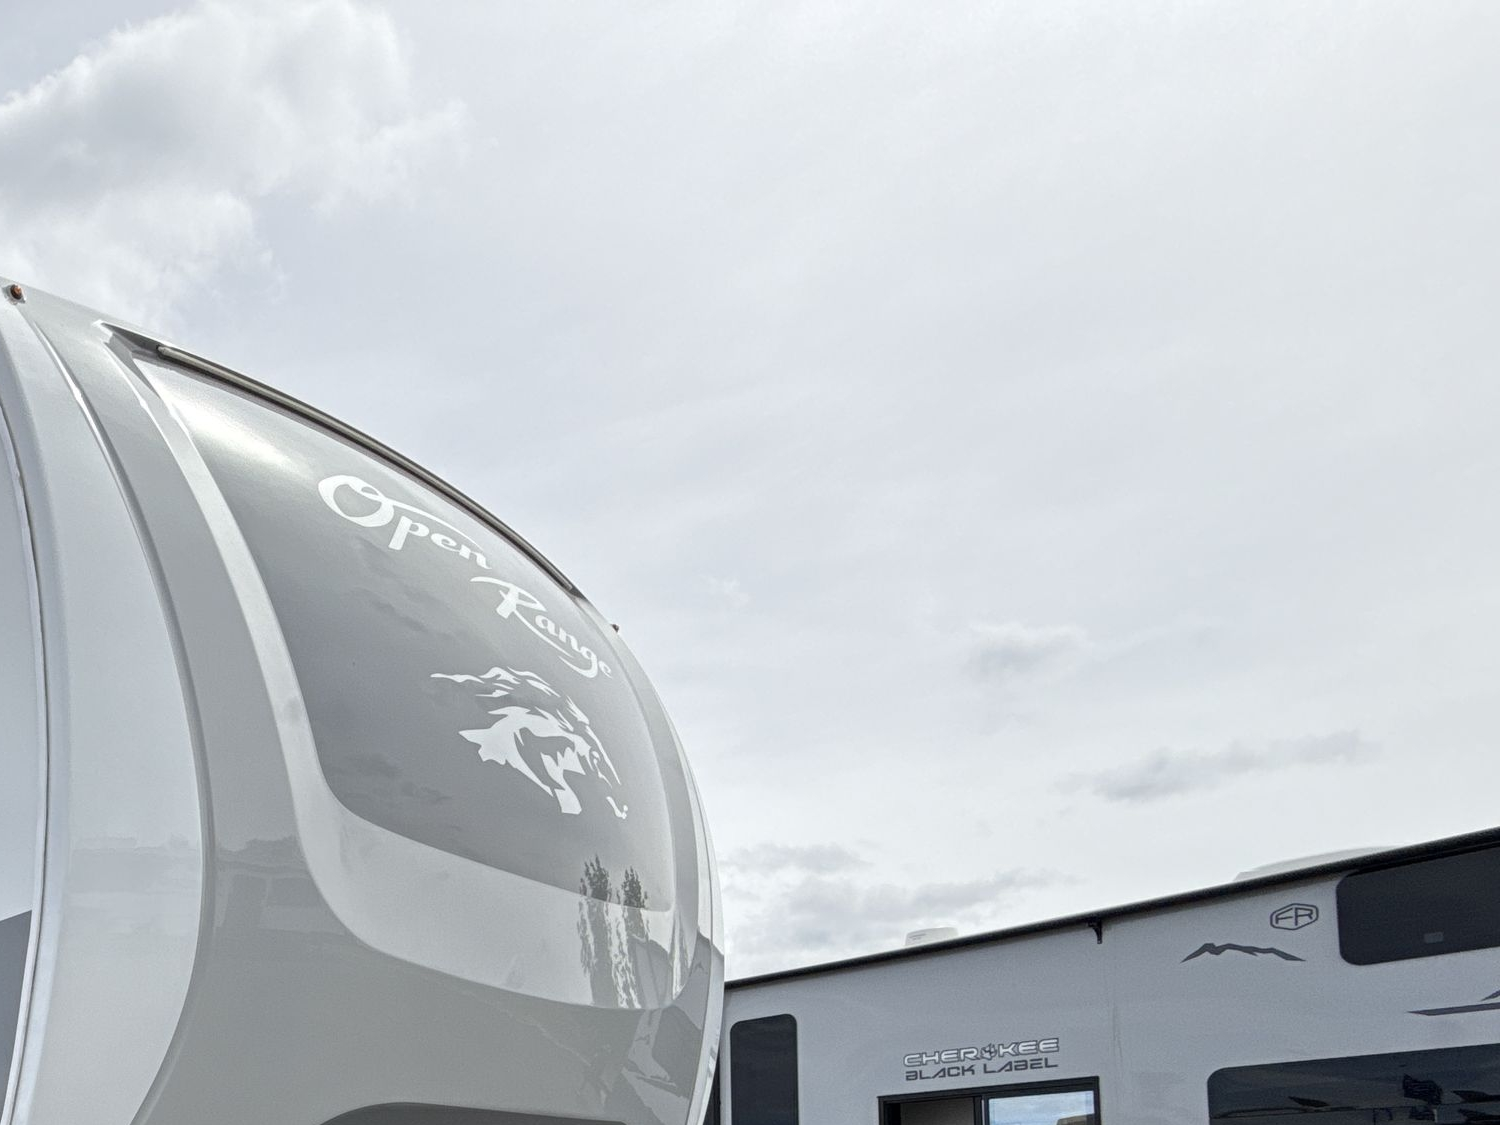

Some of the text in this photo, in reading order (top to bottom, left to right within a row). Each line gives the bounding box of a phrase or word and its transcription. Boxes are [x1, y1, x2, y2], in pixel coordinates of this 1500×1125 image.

[318, 474, 492, 570] Open
[470, 576, 613, 679] Range
[905, 1057, 1059, 1081] BLACK LABEL
